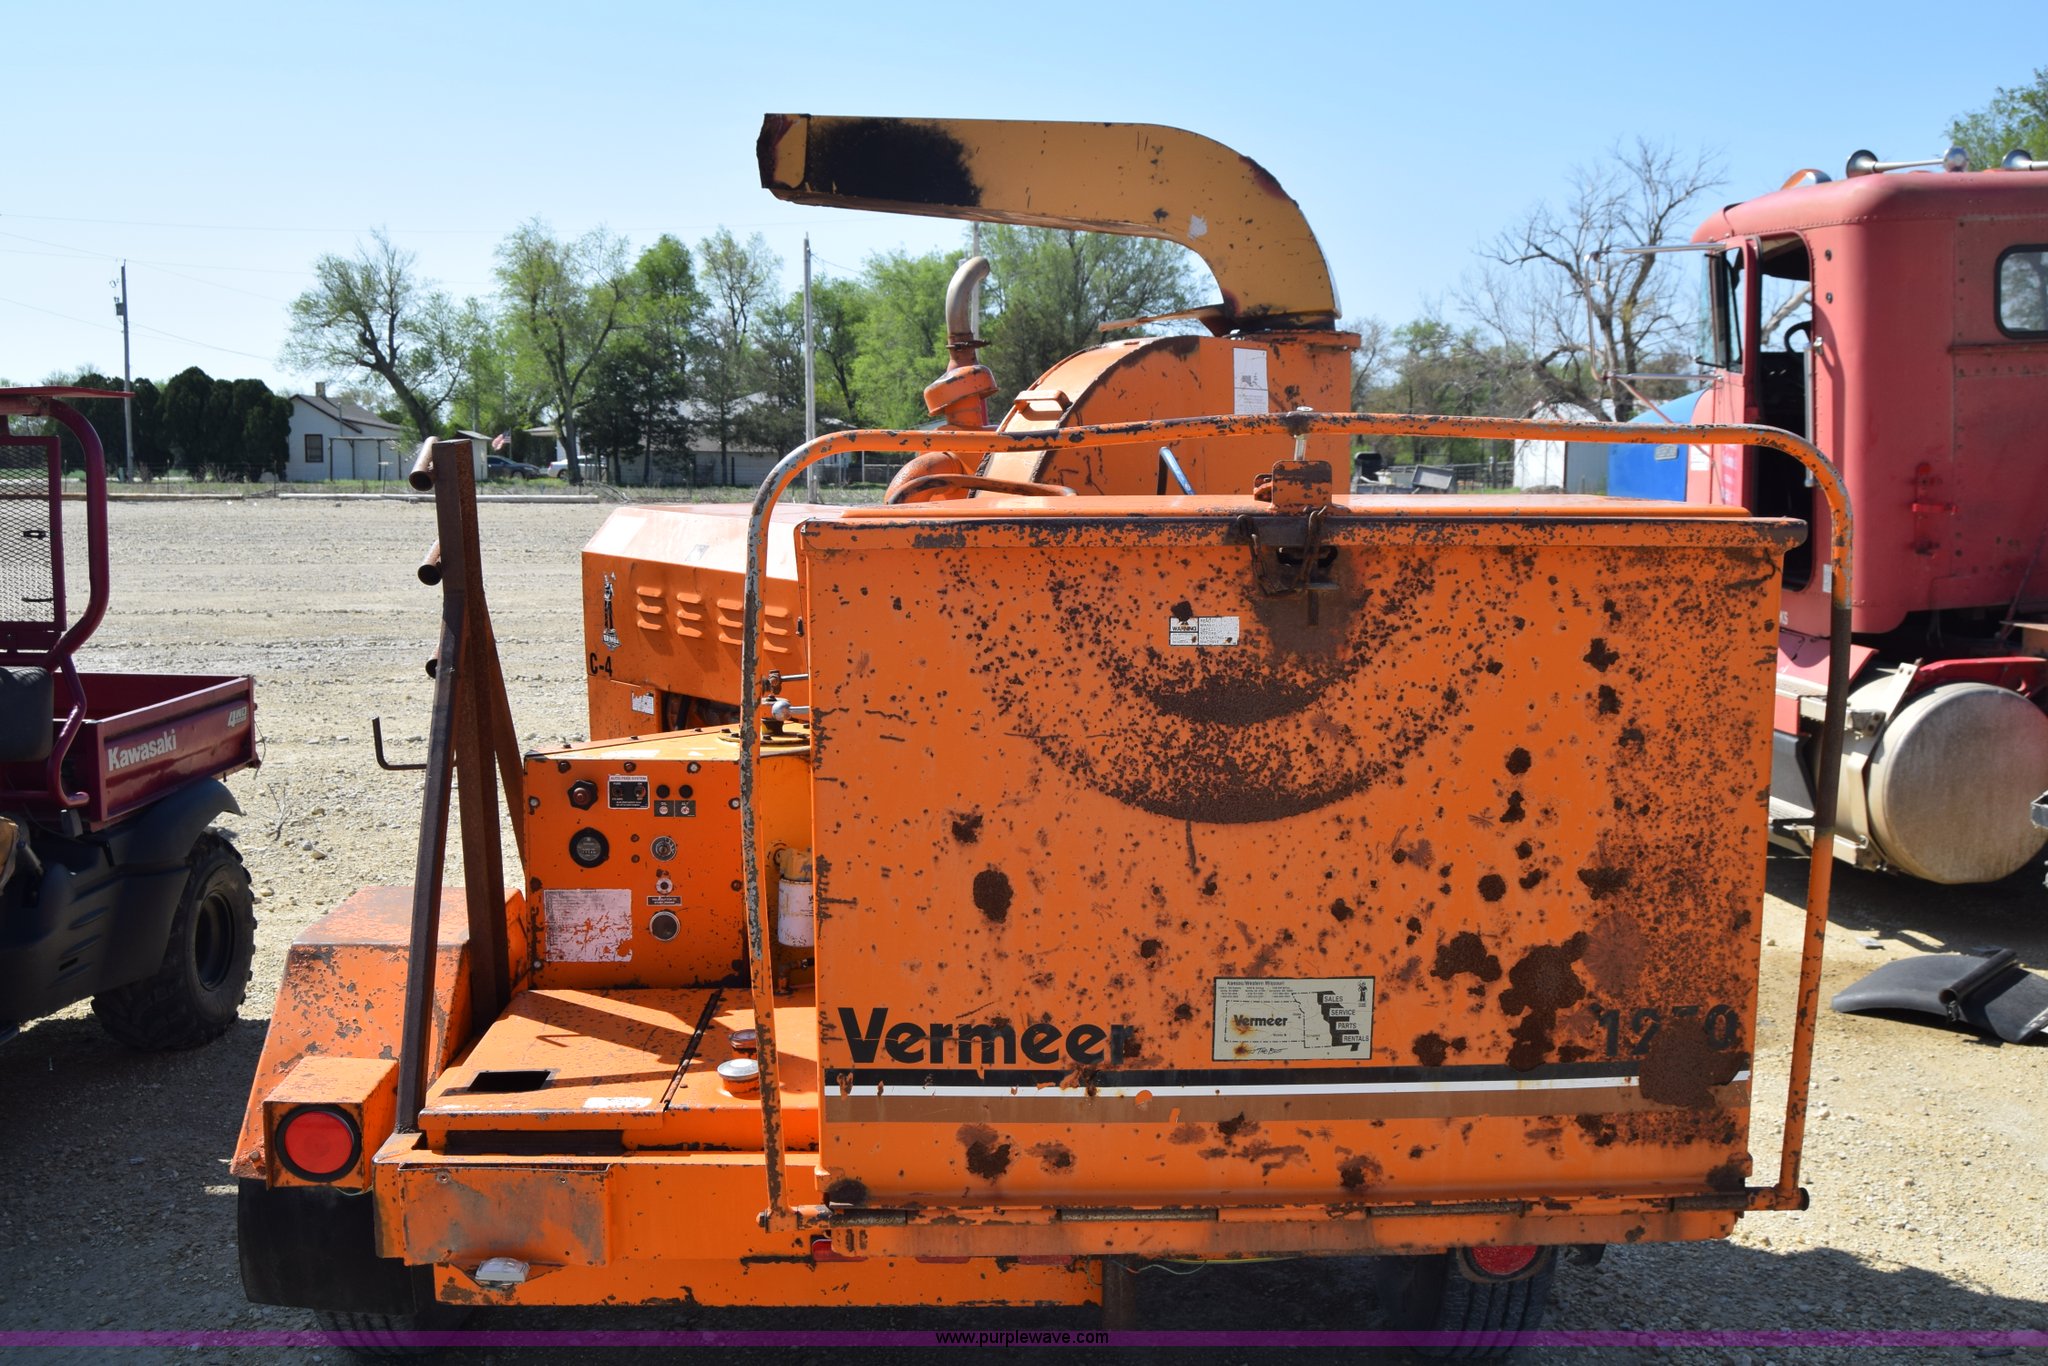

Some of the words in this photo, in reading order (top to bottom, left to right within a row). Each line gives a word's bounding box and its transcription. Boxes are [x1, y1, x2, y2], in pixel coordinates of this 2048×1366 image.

[590, 652, 613, 677] C-4
[108, 729, 177, 771] Kawasaki
[838, 1007, 1134, 1065] Vermeer
[1233, 1014, 1288, 1026] Vermeer
[1599, 1004, 1740, 1056] 120
